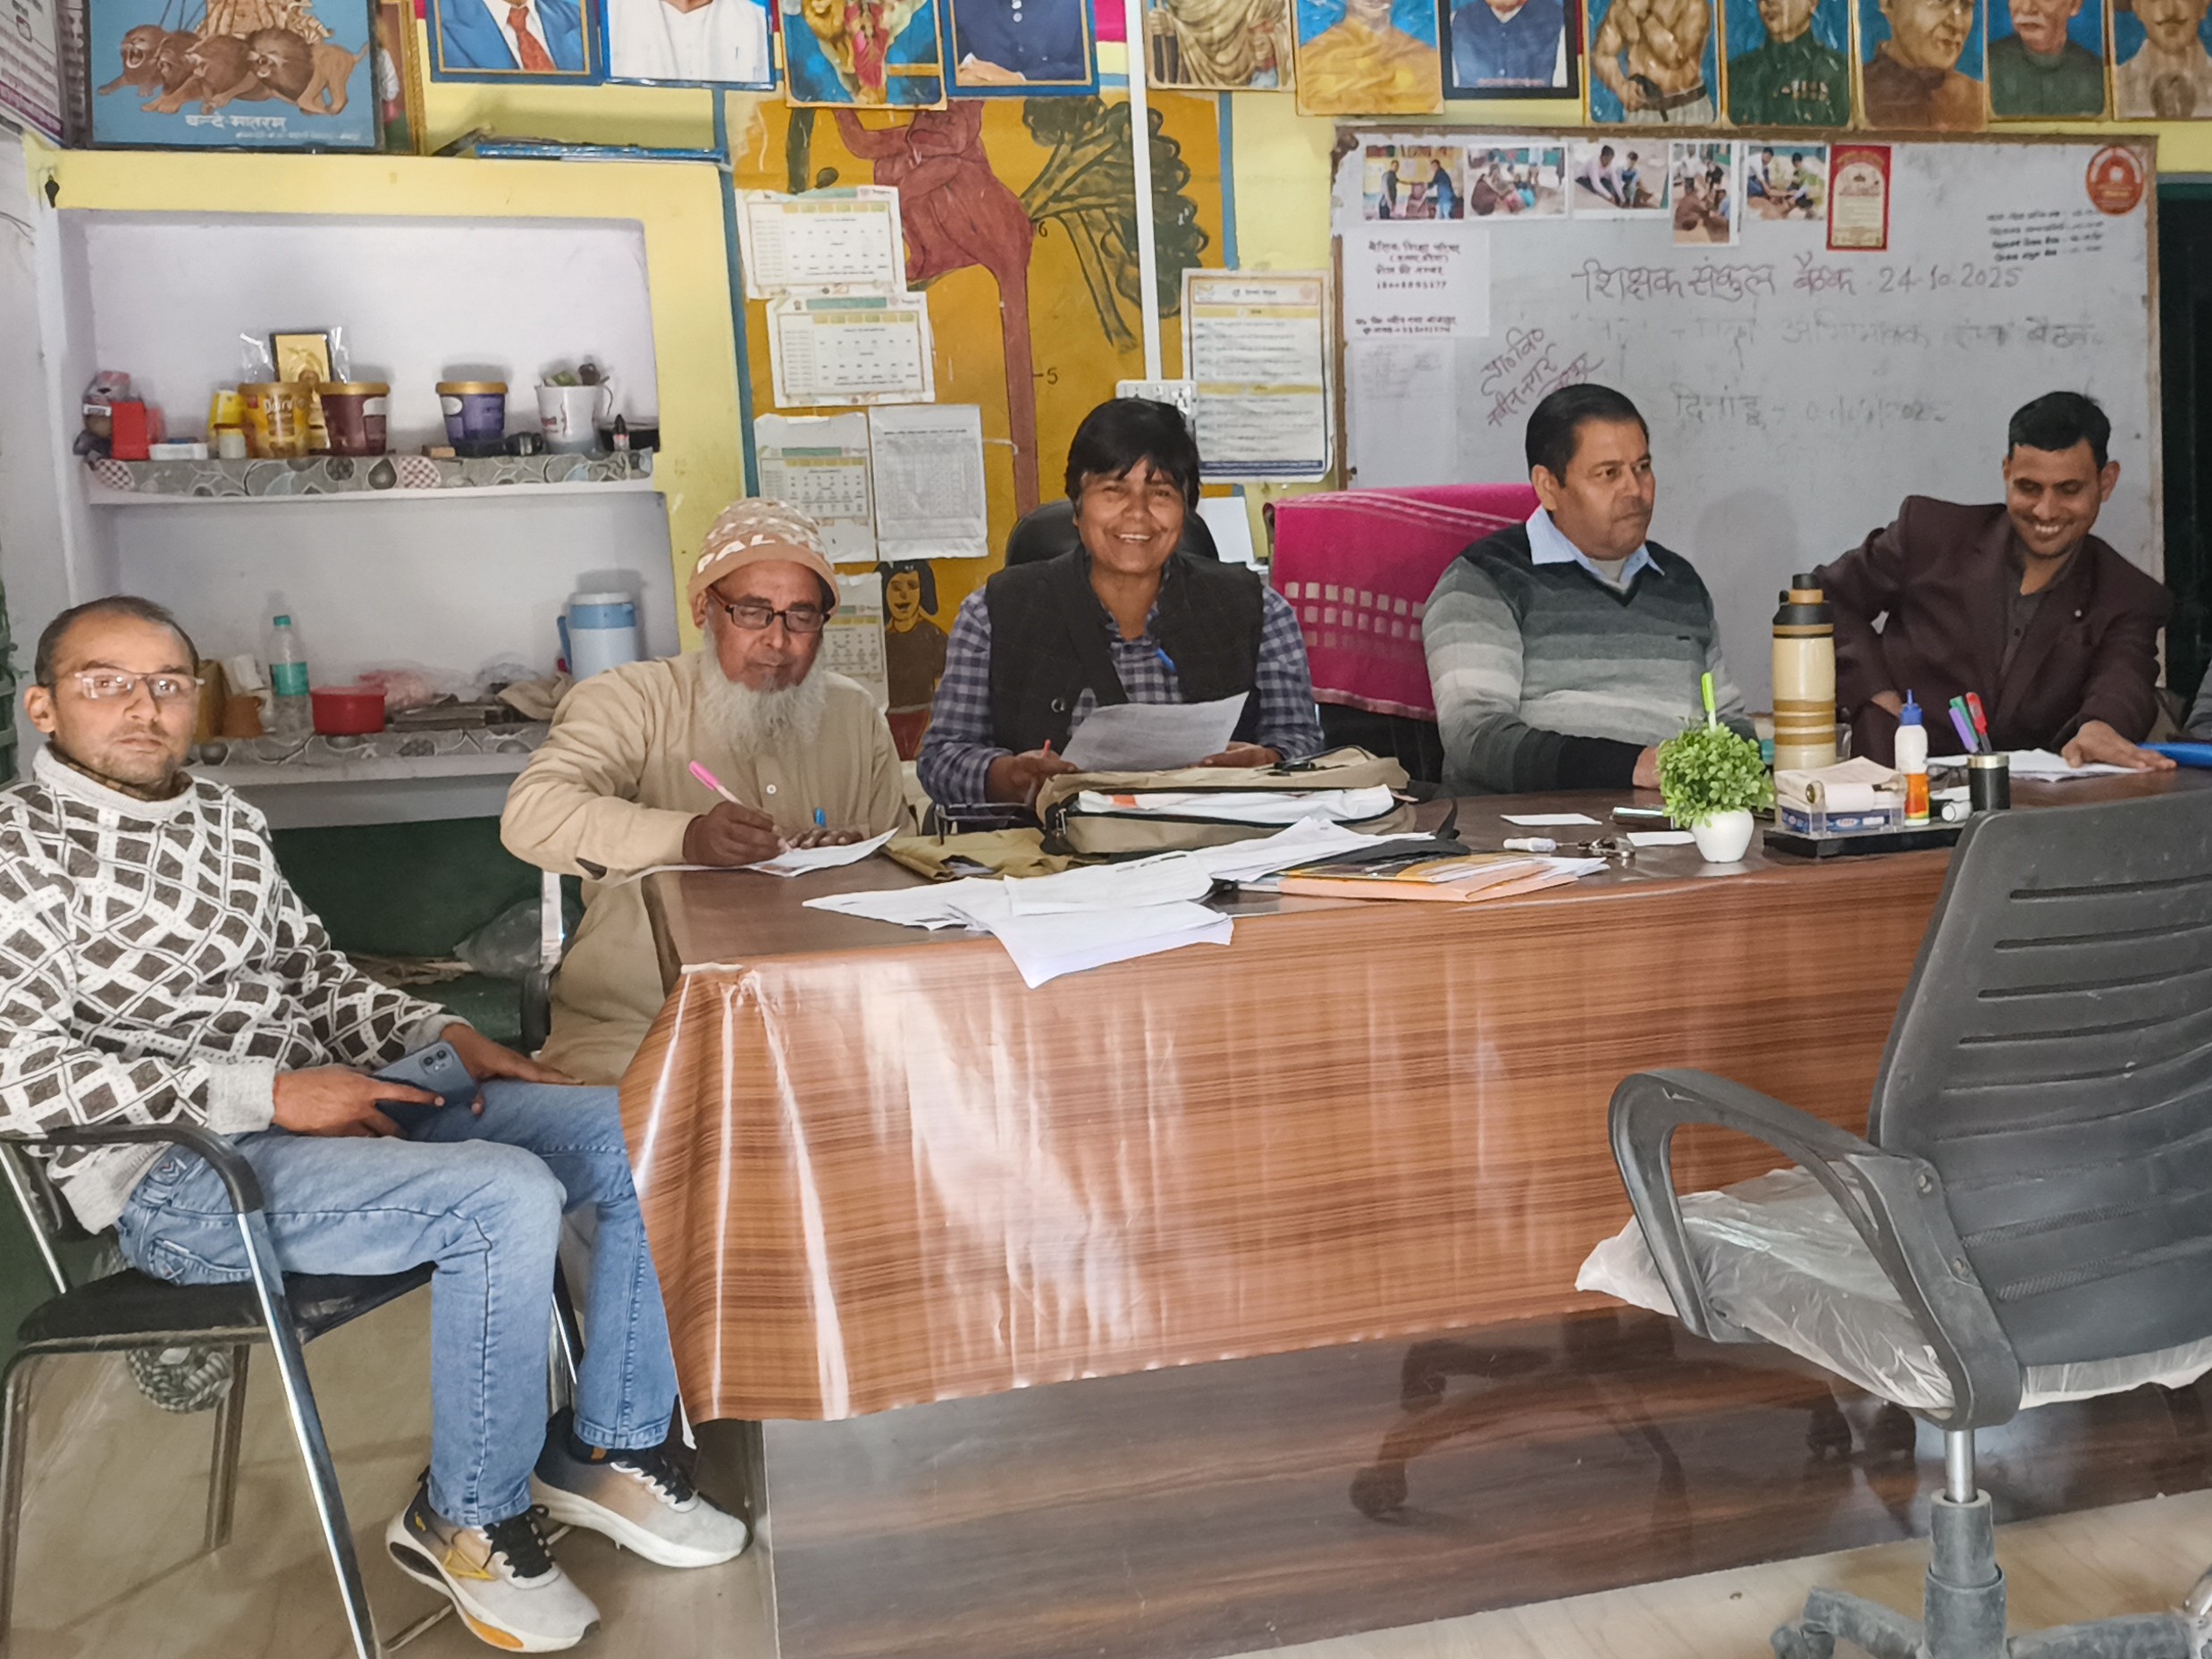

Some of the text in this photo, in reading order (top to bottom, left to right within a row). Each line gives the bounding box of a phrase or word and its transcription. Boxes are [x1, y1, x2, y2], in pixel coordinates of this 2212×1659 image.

[1039, 221, 1048, 238] 6
[1571, 258, 1684, 302] शिक्षक
[1687, 256, 1776, 302] संकुल
[1047, 366, 1058, 384] 5
